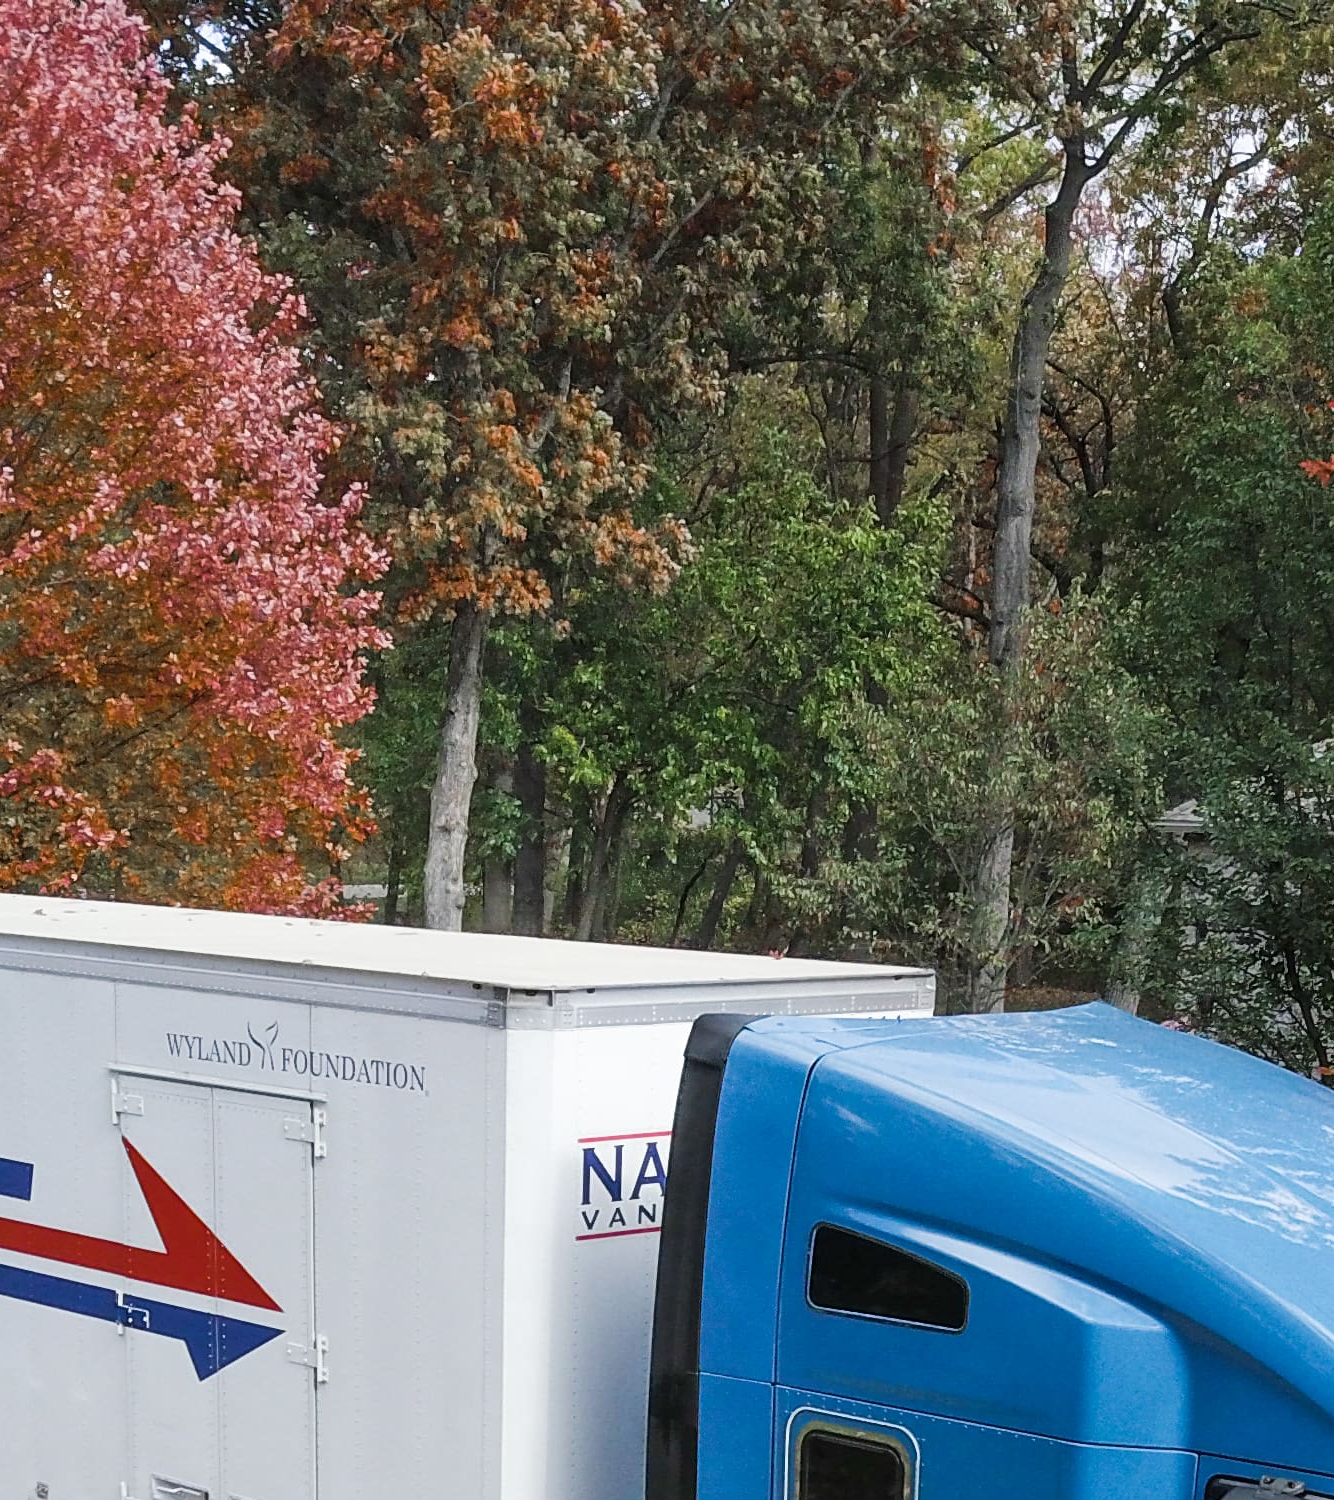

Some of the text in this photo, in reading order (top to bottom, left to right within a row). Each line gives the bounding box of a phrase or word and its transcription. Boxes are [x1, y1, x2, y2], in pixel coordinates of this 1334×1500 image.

[166, 1032, 427, 1092] WYLAND FOUNDATION
[581, 1203, 657, 1231] VAN
